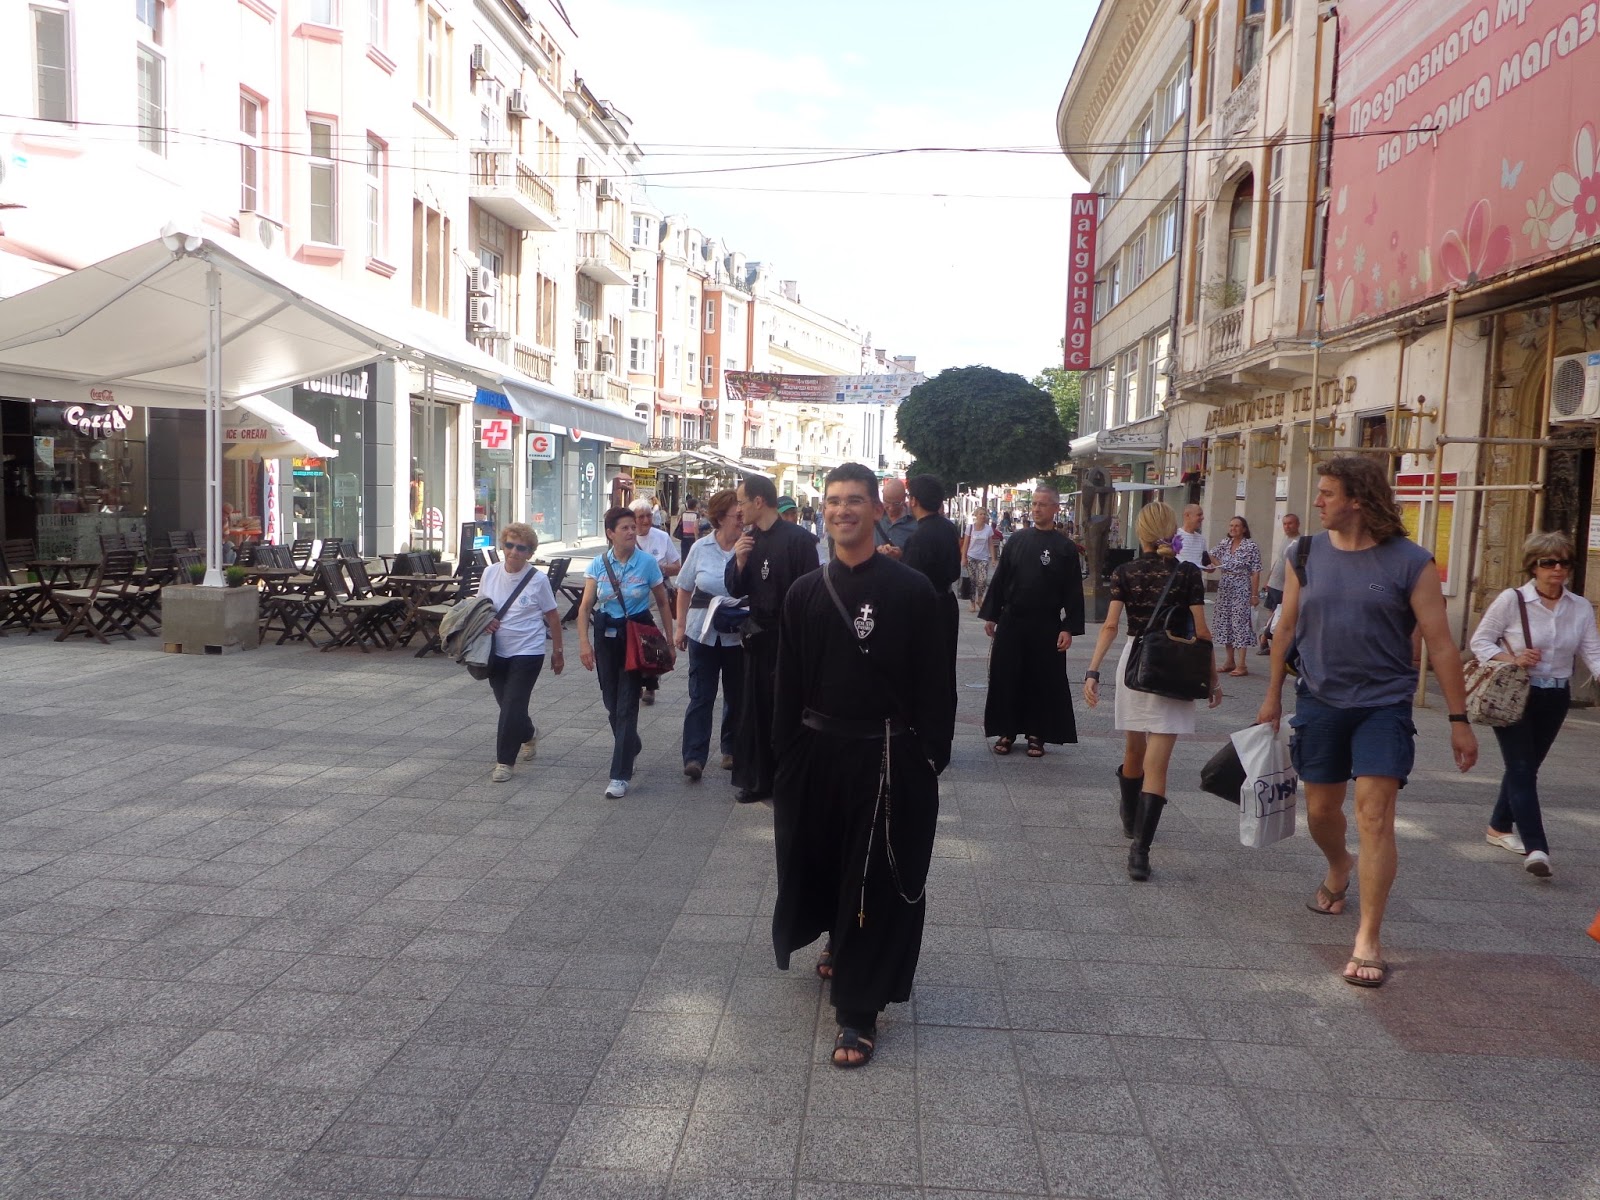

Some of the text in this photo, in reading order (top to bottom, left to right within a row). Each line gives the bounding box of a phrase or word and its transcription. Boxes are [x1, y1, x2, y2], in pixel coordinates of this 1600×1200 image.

[1349, 8, 1489, 141] Предпазната
[1377, 2, 1600, 174] на верига магаз
[1070, 199, 1095, 365] Макдоналдс
[226, 429, 237, 440] ICE
[241, 428, 268, 440] CREAM
